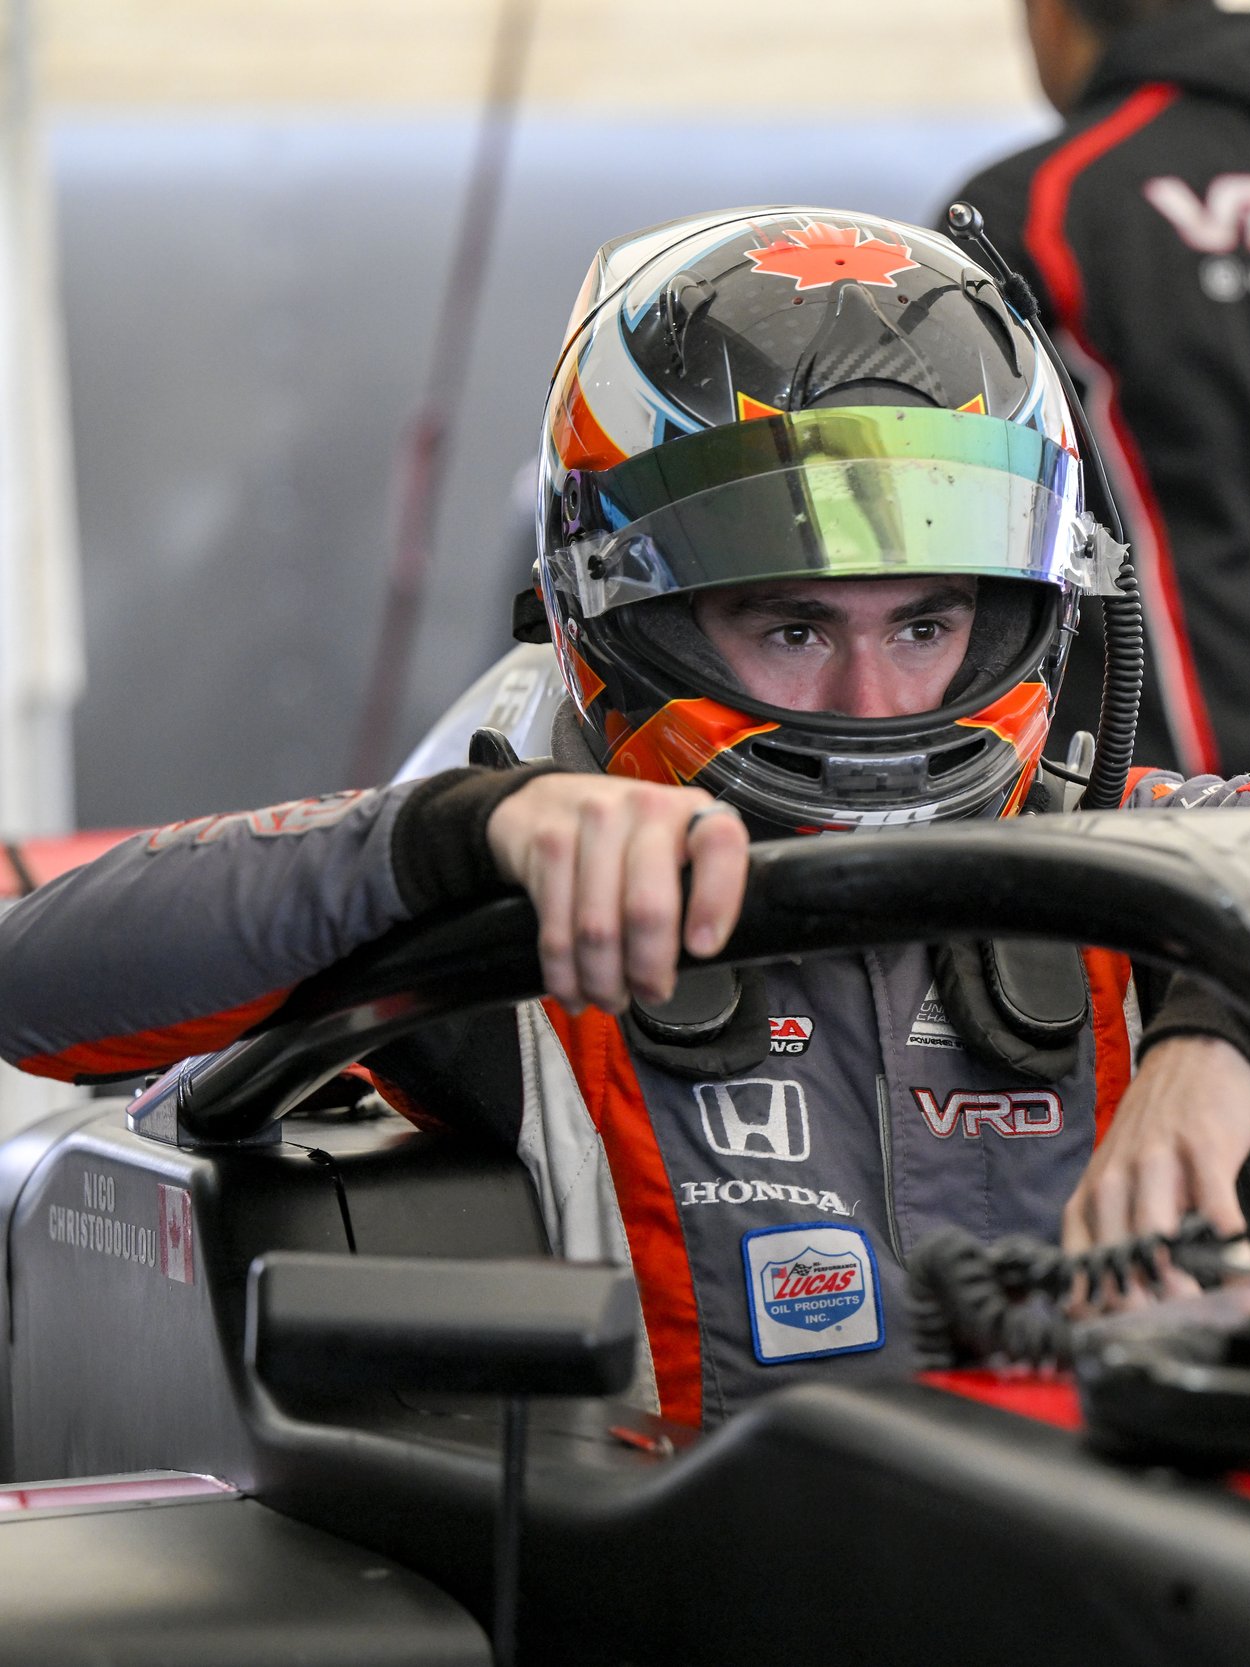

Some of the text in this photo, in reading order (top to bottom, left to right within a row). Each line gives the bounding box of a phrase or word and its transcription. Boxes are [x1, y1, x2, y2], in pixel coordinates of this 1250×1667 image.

[910, 1087, 1064, 1139] VRD
[84, 1171, 115, 1213] NICO
[680, 1179, 850, 1217] HONDA
[50, 1203, 156, 1268] CHRISTODOULOU
[774, 1270, 856, 1300] LUCAS
[770, 1295, 860, 1315] OIL PRODUCTS
[805, 1313, 830, 1324] INC.
